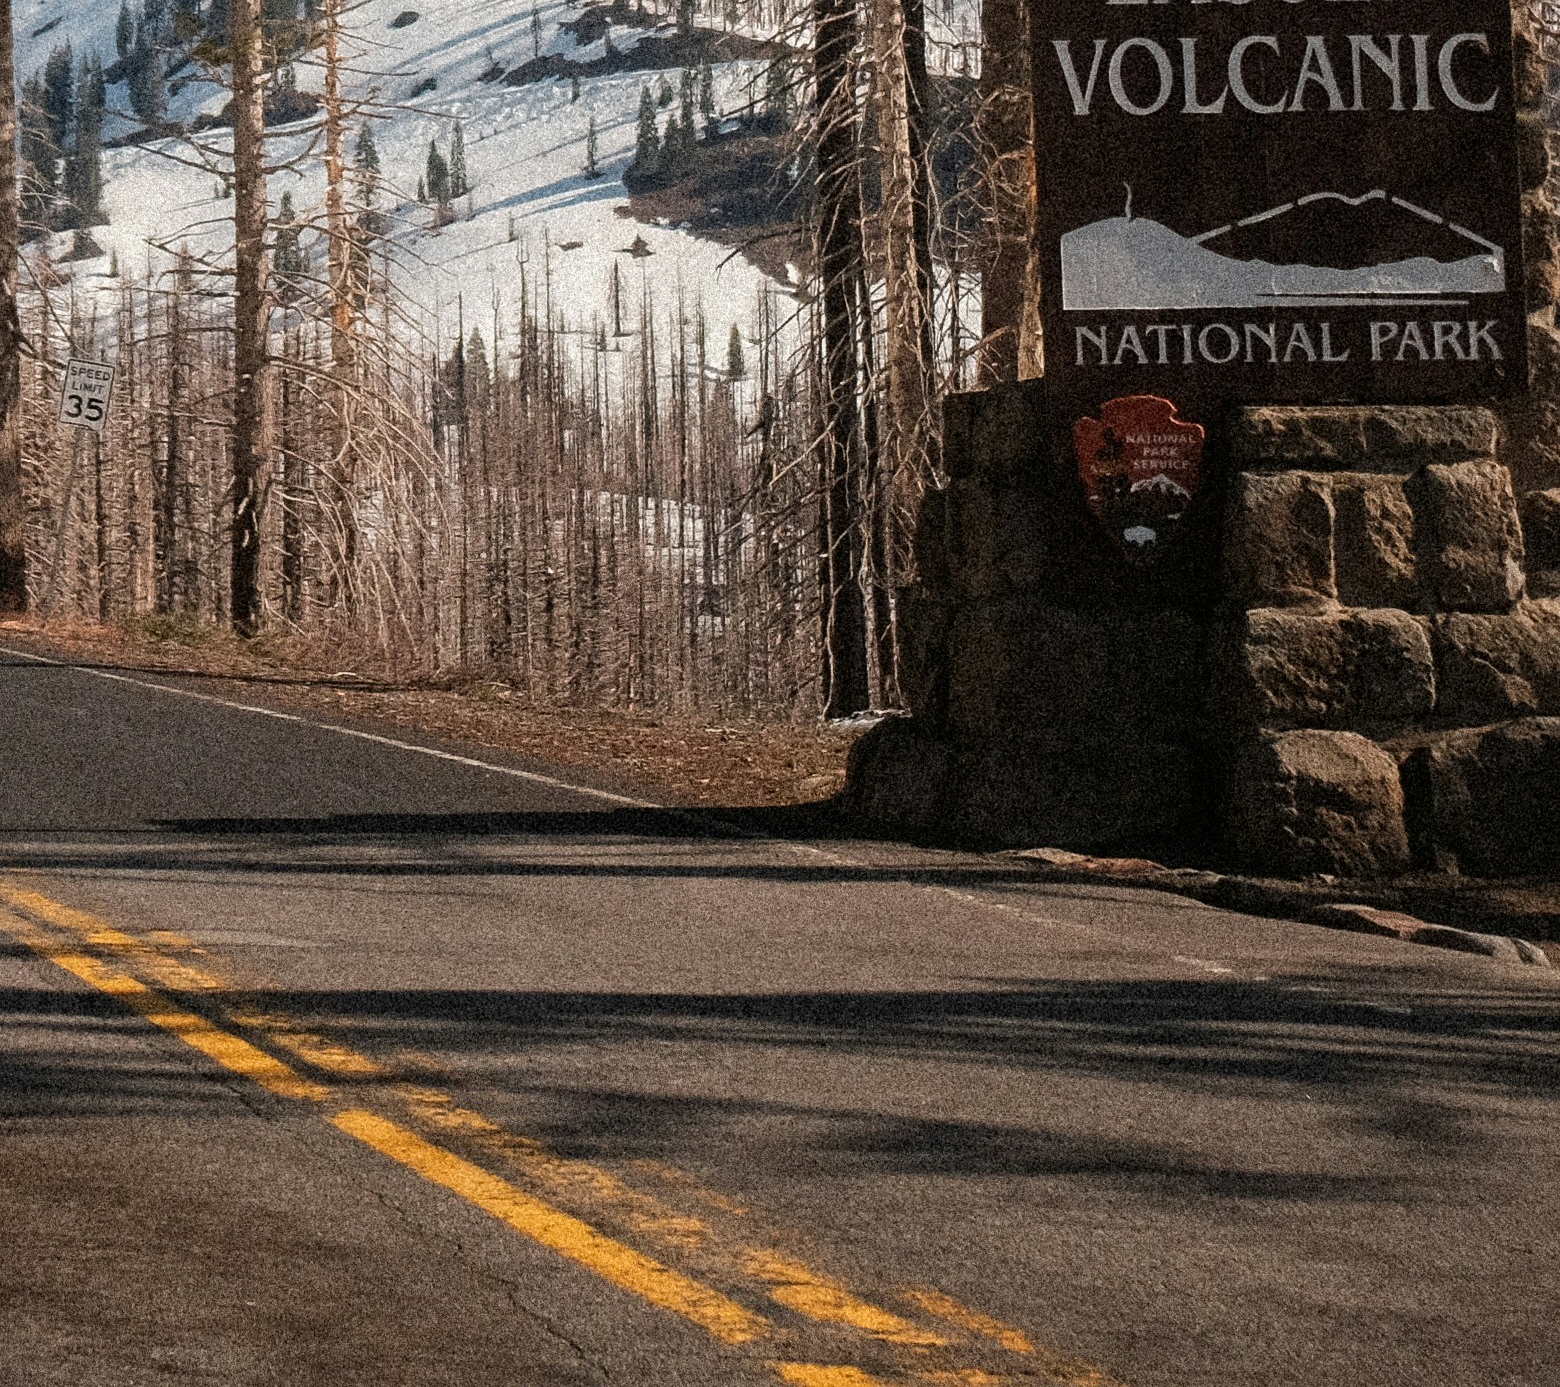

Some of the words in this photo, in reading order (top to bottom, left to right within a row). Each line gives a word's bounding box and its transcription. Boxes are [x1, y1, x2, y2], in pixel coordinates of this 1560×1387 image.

[1052, 32, 1499, 116] VOLCANIC
[1074, 322, 1349, 366] NATIONAL
[1369, 320, 1504, 362] PARK
[70, 366, 111, 381] SPEED
[71, 381, 105, 394] LIMIT
[64, 394, 106, 422] 35
[1125, 433, 1197, 444] NATIONAL
[1142, 446, 1179, 457] PARK
[1132, 459, 1190, 470] SERVICE
